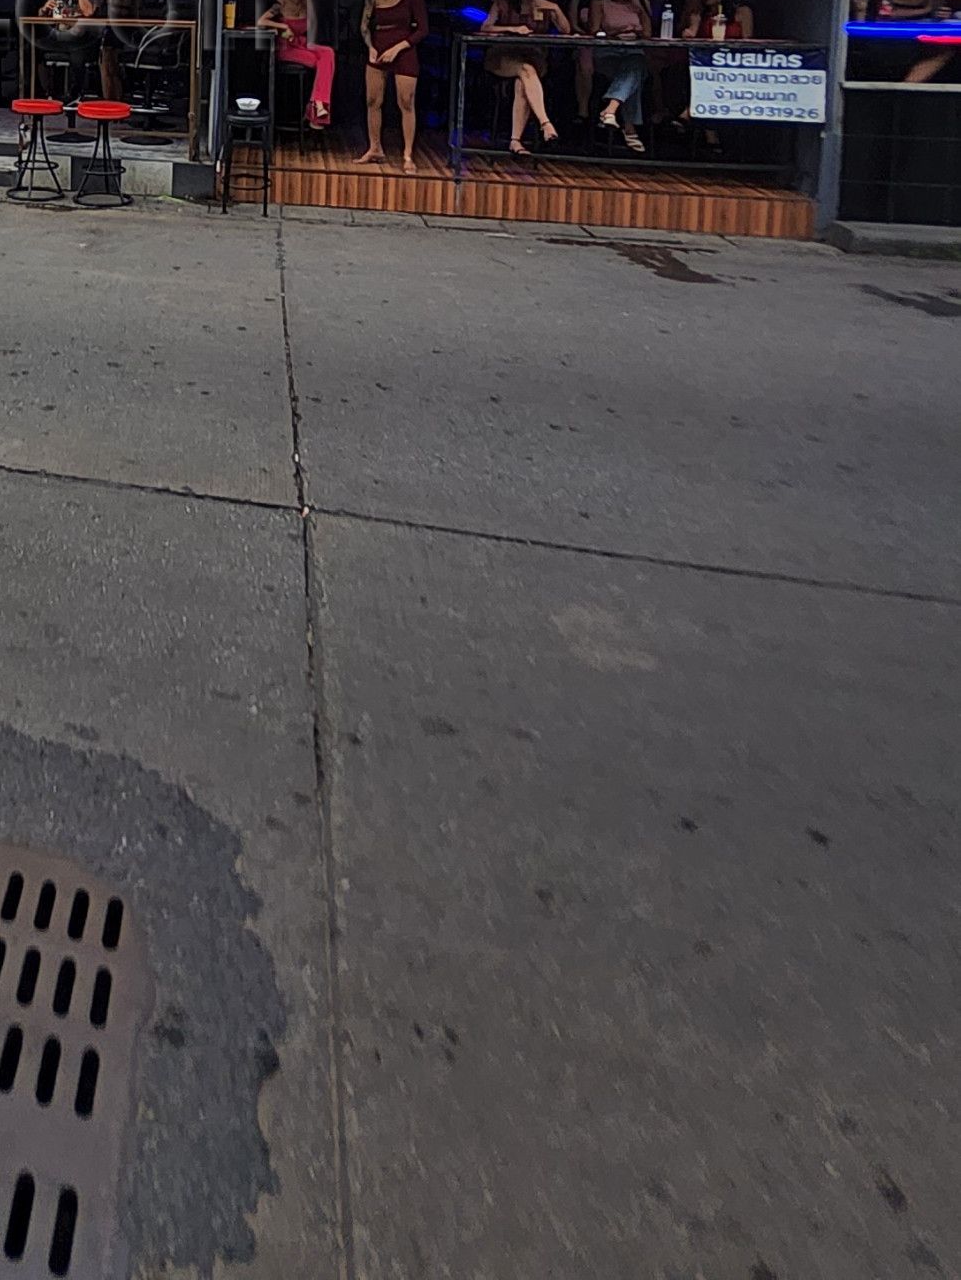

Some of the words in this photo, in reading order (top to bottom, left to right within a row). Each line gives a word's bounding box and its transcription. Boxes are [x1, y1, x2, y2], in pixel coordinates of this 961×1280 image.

[711, 47, 803, 68] รับสมัคร
[714, 85, 798, 101] จำนวนมาก
[695, 103, 820, 119] 089-0931926
